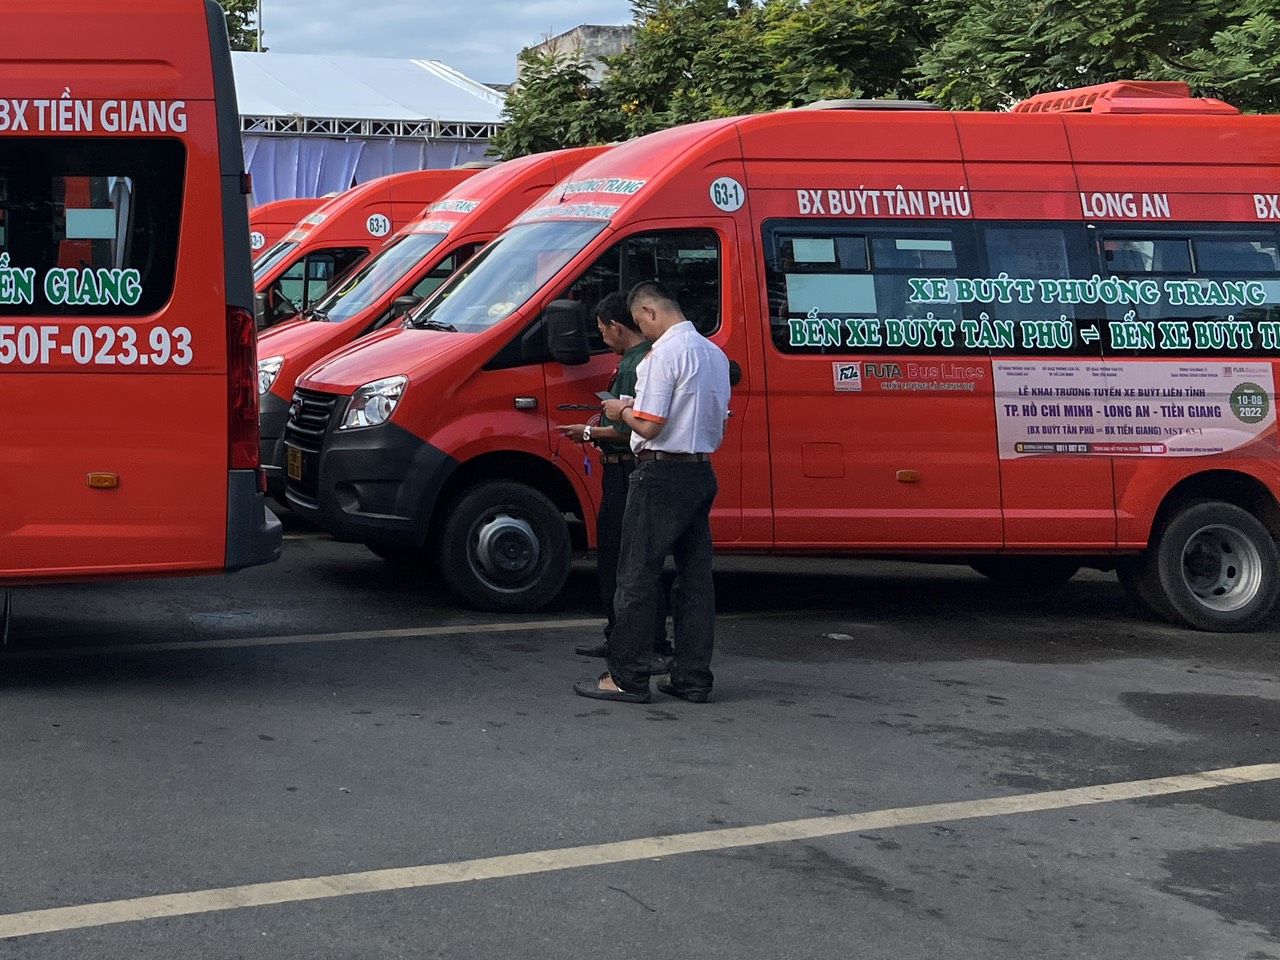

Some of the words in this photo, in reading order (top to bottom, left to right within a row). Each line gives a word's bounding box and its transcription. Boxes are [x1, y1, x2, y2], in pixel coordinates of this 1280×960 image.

[33, 86, 93, 132] TIỀN
[100, 100, 187, 133] GIANG
[714, 183, 740, 206] 63-1
[797, 190, 825, 214] BX
[828, 185, 880, 215] BUÝT
[883, 185, 925, 215] TÂN
[928, 186, 970, 216] PHÚ
[1080, 192, 1137, 217] LONG
[1142, 193, 1170, 218] AN
[1253, 194, 1280, 219] BX
[369, 218, 387, 233] 63-1
[44, 268, 142, 306] GIANG
[908, 277, 950, 303] XE
[954, 272, 1034, 303] BUÝT
[1038, 274, 1161, 304] PHƯƠNG
[1164, 280, 1267, 305] TRANG
[788, 307, 841, 347] BẾN
[845, 318, 882, 347] XE
[961, 312, 1015, 348] TÂN
[1109, 310, 1155, 349] BẾN
[1158, 321, 1191, 349] XE
[864, 363, 903, 379] FUTA
[906, 363, 939, 379] Bus
[941, 363, 985, 379] Lines
[1032, 388, 1052, 396] KHAI
[1124, 388, 1135, 397] XE
[1163, 387, 1182, 397] LIÊN
[1237, 395, 1263, 405] 10-08
[1022, 401, 1038, 417] HỒ
[1041, 402, 1061, 417] CHÍ
[1064, 405, 1093, 417] MINH
[1104, 405, 1132, 418] LONG
[1135, 405, 1150, 418] AN
[1187, 405, 1222, 418] GIANG
[1240, 407, 1262, 417] 2022
[1105, 425, 1115, 435] BX
